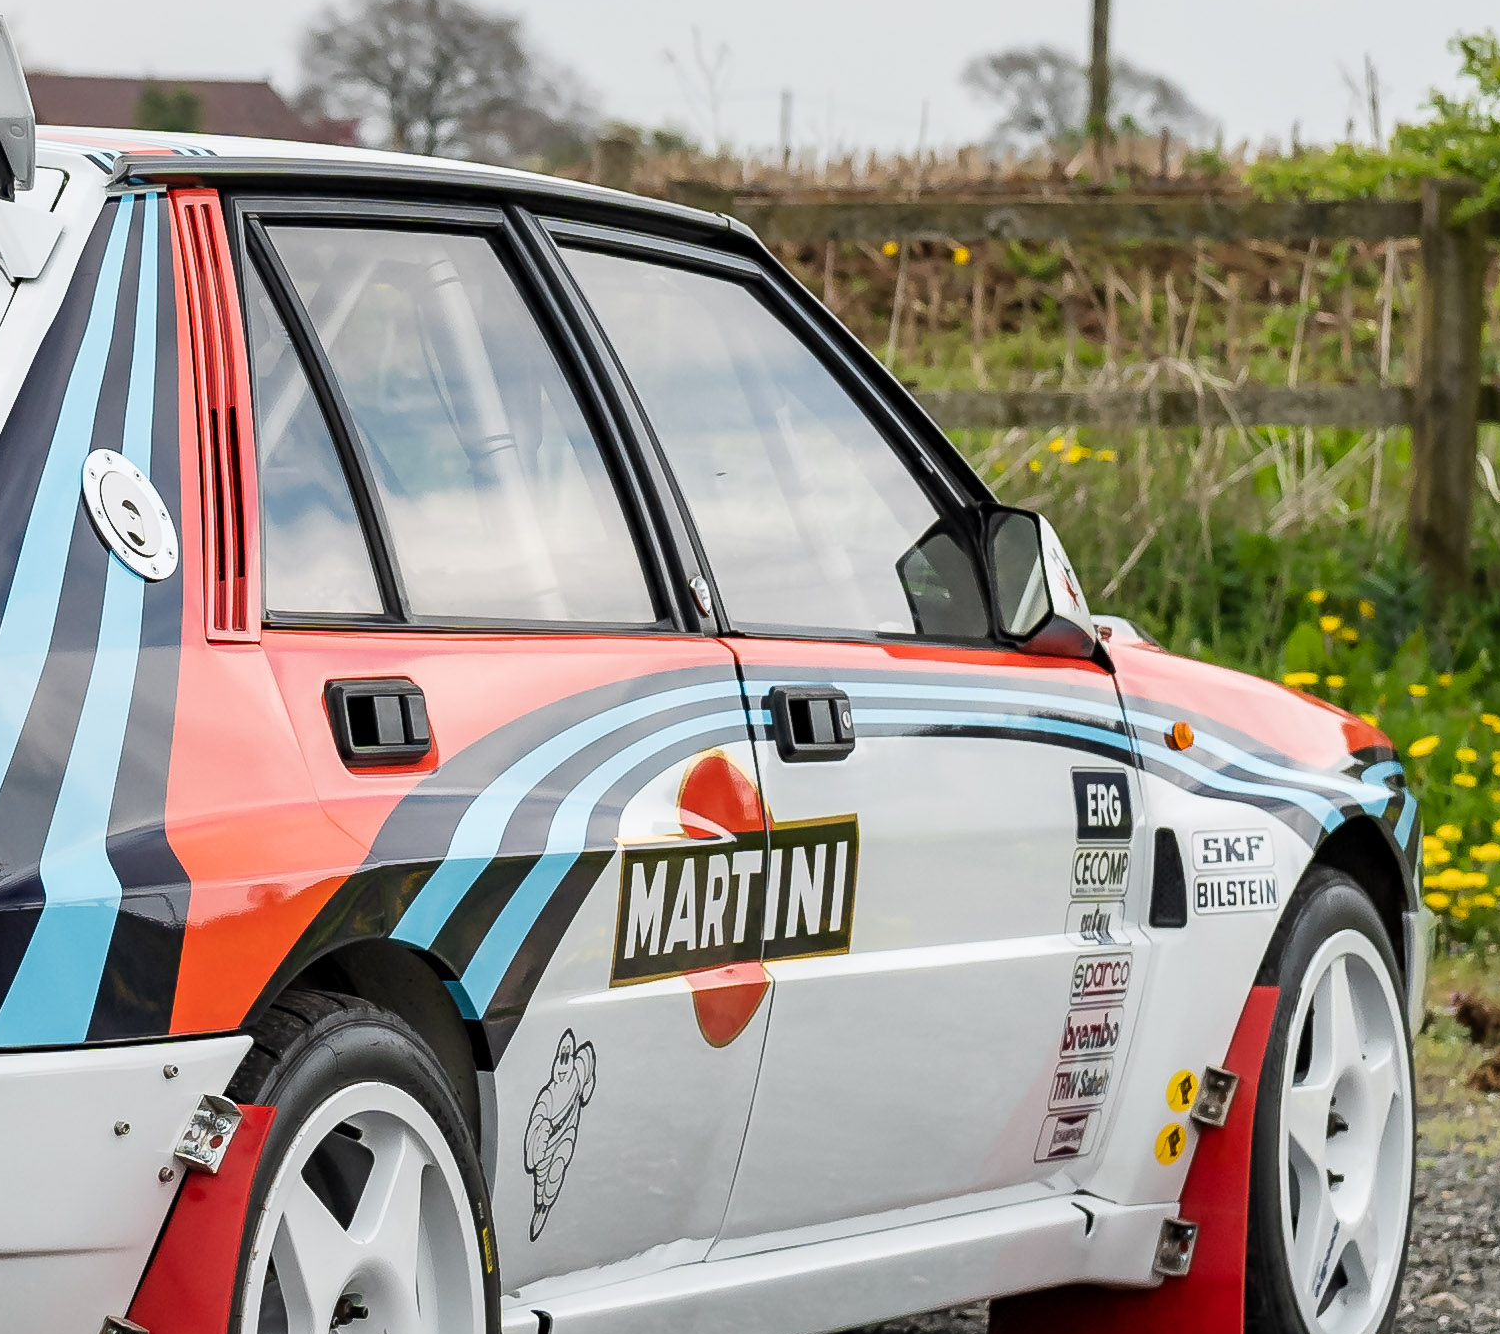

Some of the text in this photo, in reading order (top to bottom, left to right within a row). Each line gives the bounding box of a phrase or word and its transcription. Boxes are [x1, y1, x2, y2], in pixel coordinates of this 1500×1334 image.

[1086, 783, 1121, 827] ERG
[1074, 850, 1128, 885] CECOMP
[1202, 835, 1264, 864] SKF
[624, 840, 848, 959] MARTINI
[1197, 878, 1277, 908] BILSTEIN
[1073, 960, 1130, 998] sparco
[1061, 1012, 1119, 1051] brembo
